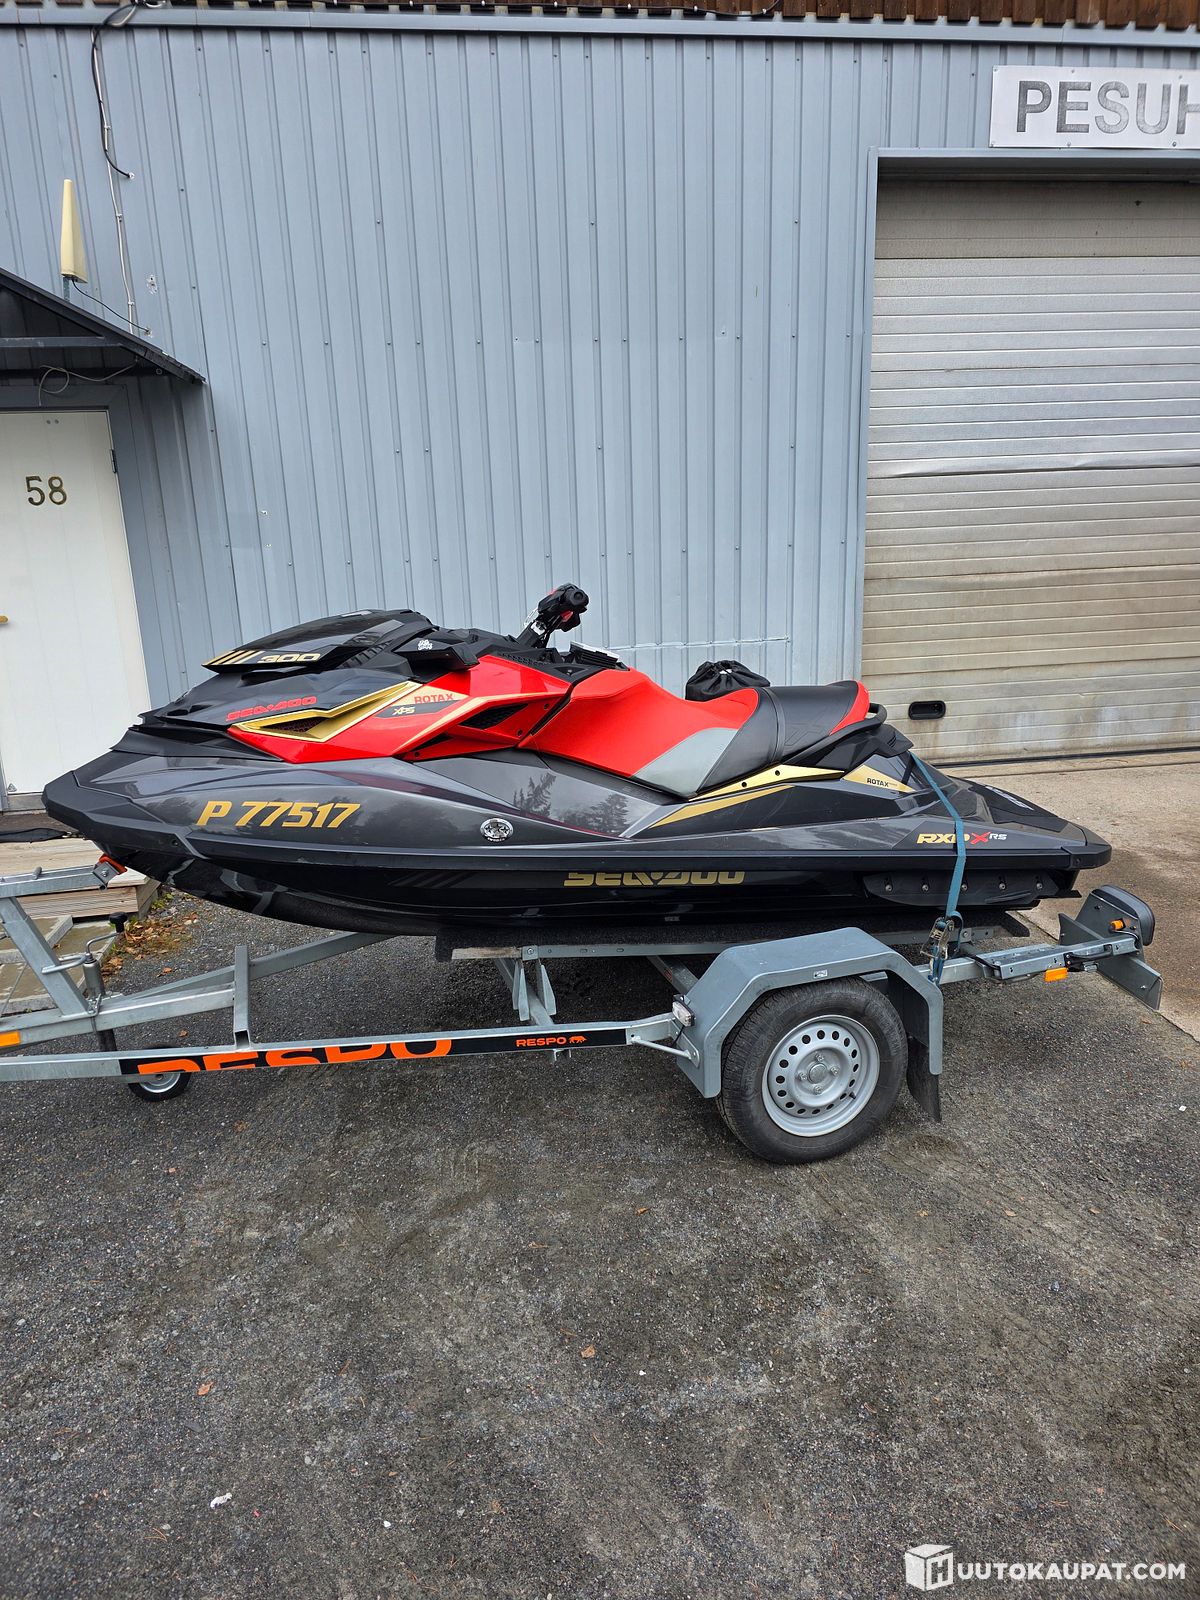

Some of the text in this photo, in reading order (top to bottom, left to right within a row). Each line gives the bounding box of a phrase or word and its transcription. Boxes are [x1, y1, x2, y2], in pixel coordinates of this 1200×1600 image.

[26, 475, 67, 506] 58
[257, 653, 320, 663] 300
[414, 693, 453, 704] ROTAX
[392, 706, 415, 715] XPS
[866, 777, 889, 787] ROTAX
[196, 801, 361, 828] P 77517
[989, 833, 1008, 841] RS
[516, 1036, 567, 1047] RESPO
